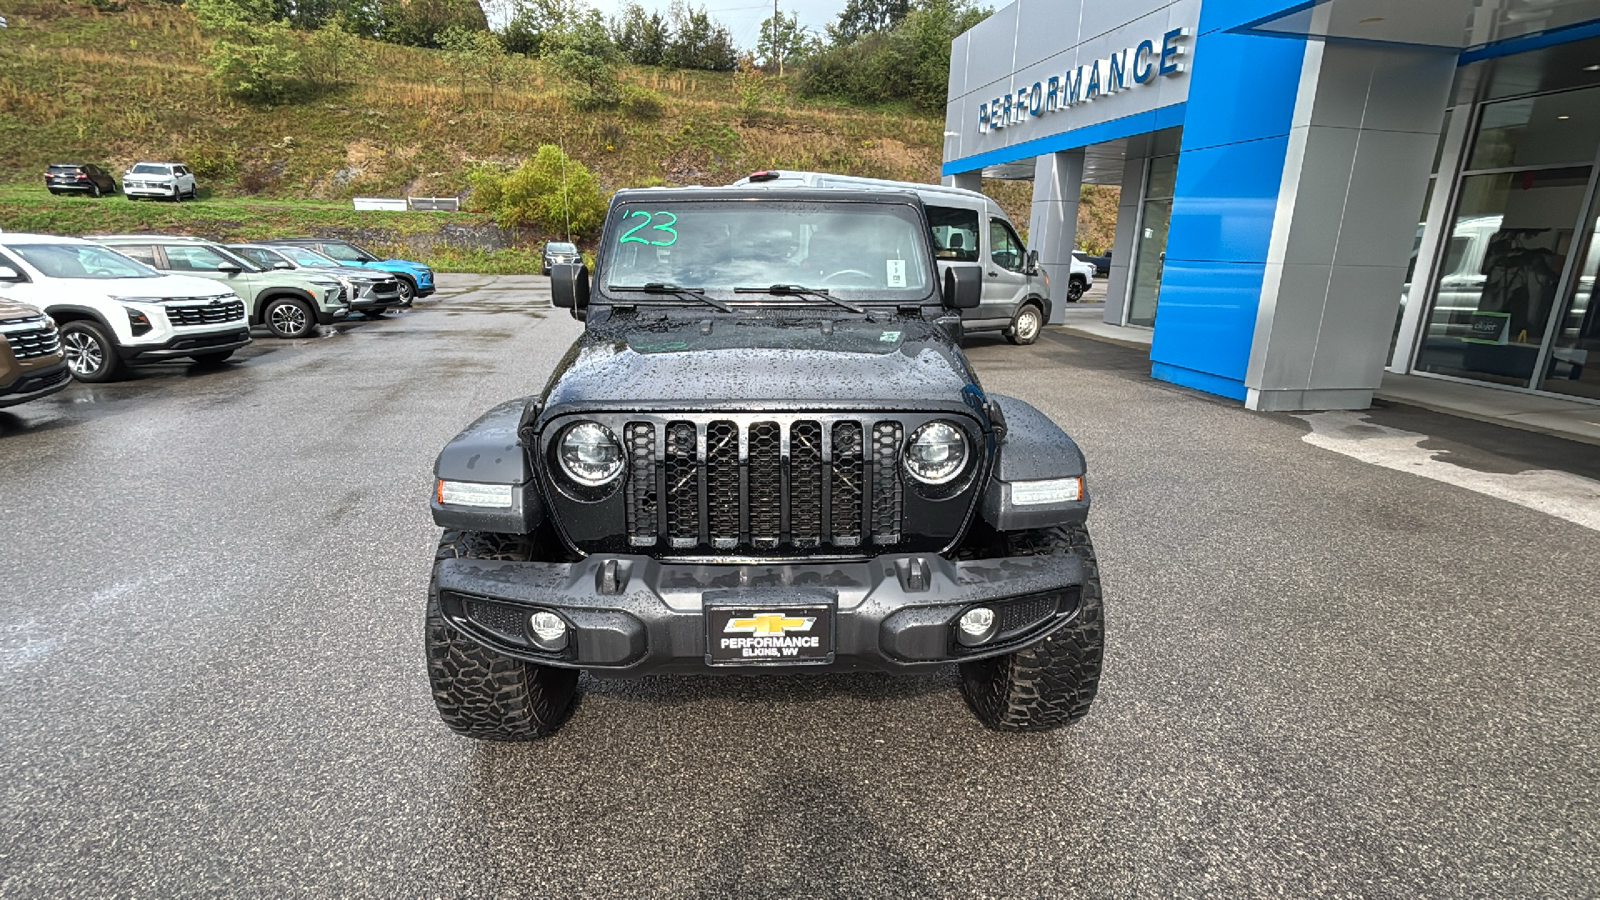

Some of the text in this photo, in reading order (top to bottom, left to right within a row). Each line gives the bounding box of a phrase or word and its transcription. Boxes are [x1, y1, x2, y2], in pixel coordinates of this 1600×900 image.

[978, 27, 1186, 133] PERFORMANCE
[620, 209, 678, 247] '23
[720, 636, 819, 649] PERFORMANCE
[742, 647, 799, 657] ELKINS, WV
